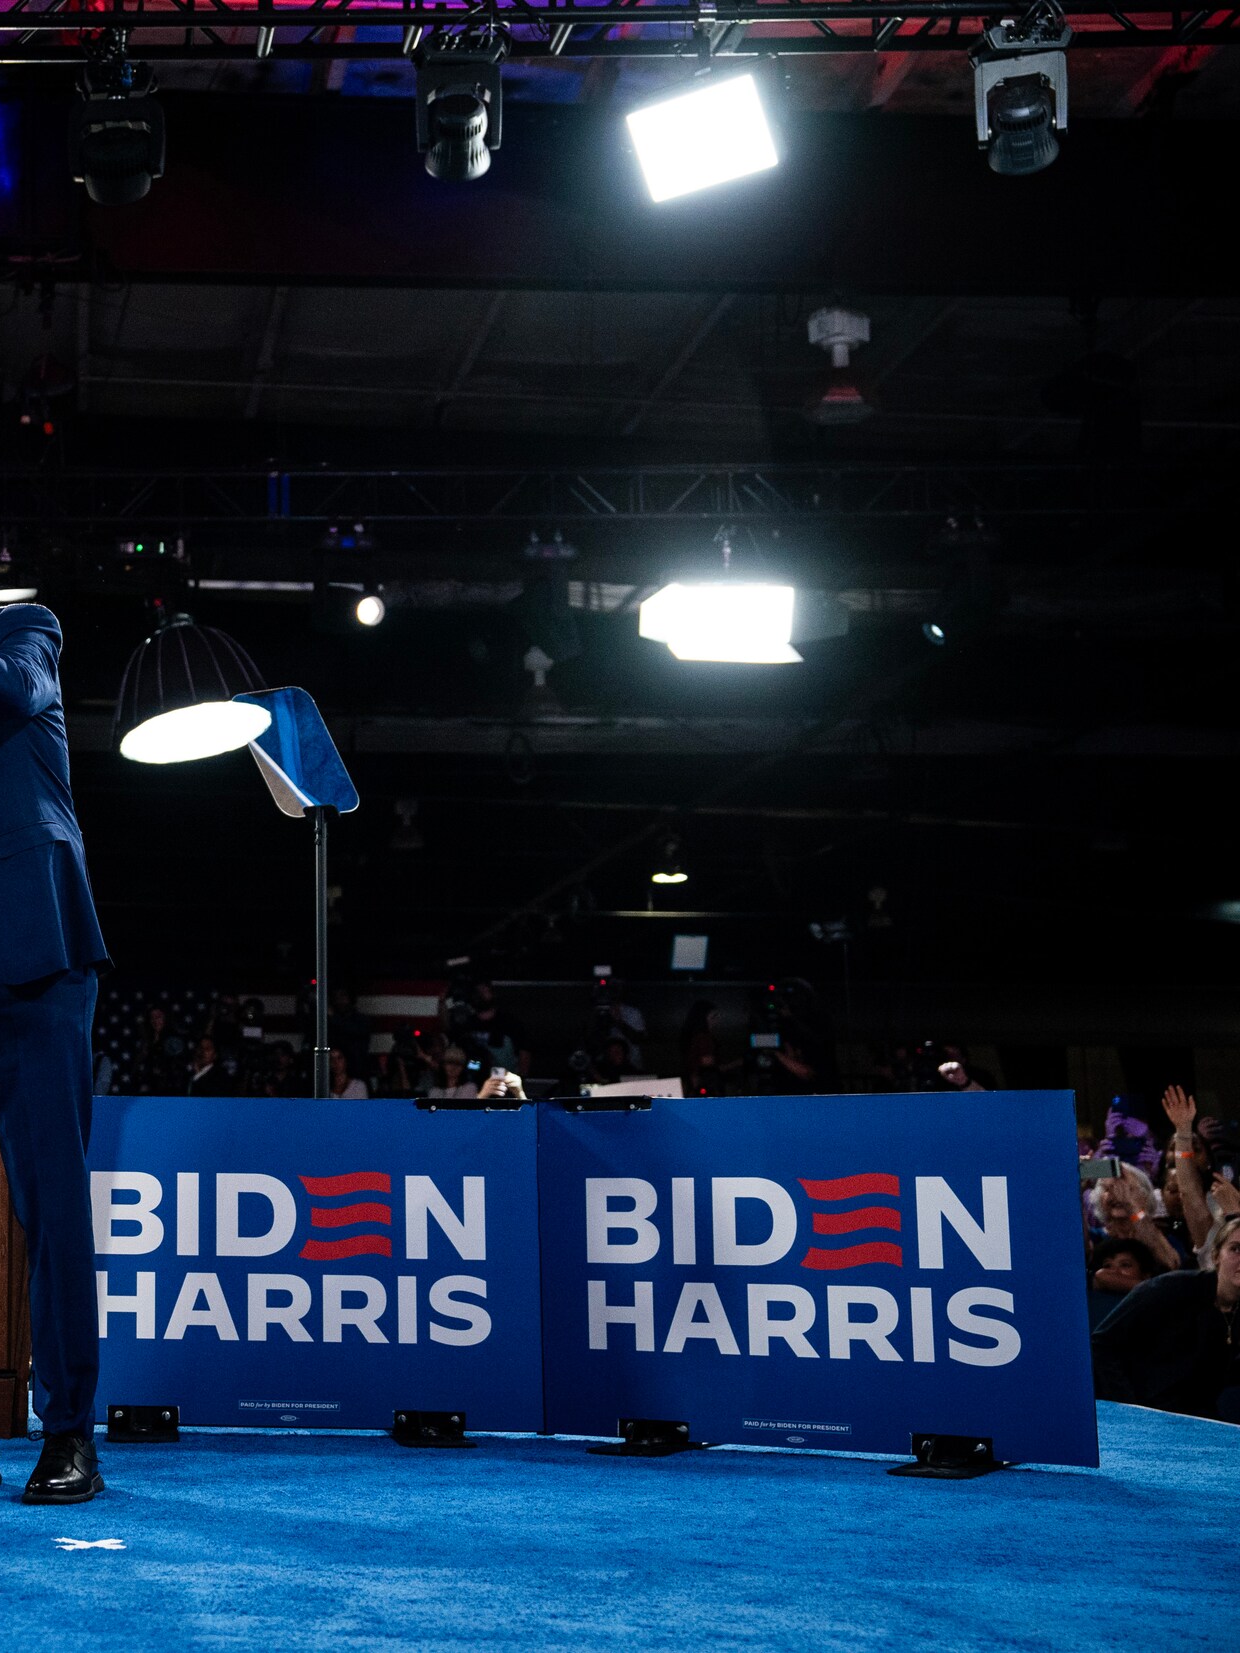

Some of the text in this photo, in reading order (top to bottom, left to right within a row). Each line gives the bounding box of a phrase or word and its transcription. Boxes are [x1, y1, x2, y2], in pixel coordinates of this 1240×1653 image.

[90, 1170, 487, 1261] BIDEN
[585, 1173, 1013, 1271] BIDEN
[96, 1271, 493, 1347] HARRIS
[587, 1280, 1022, 1367] HARRIS
[812, 1424, 850, 1432] PRESIDENT
